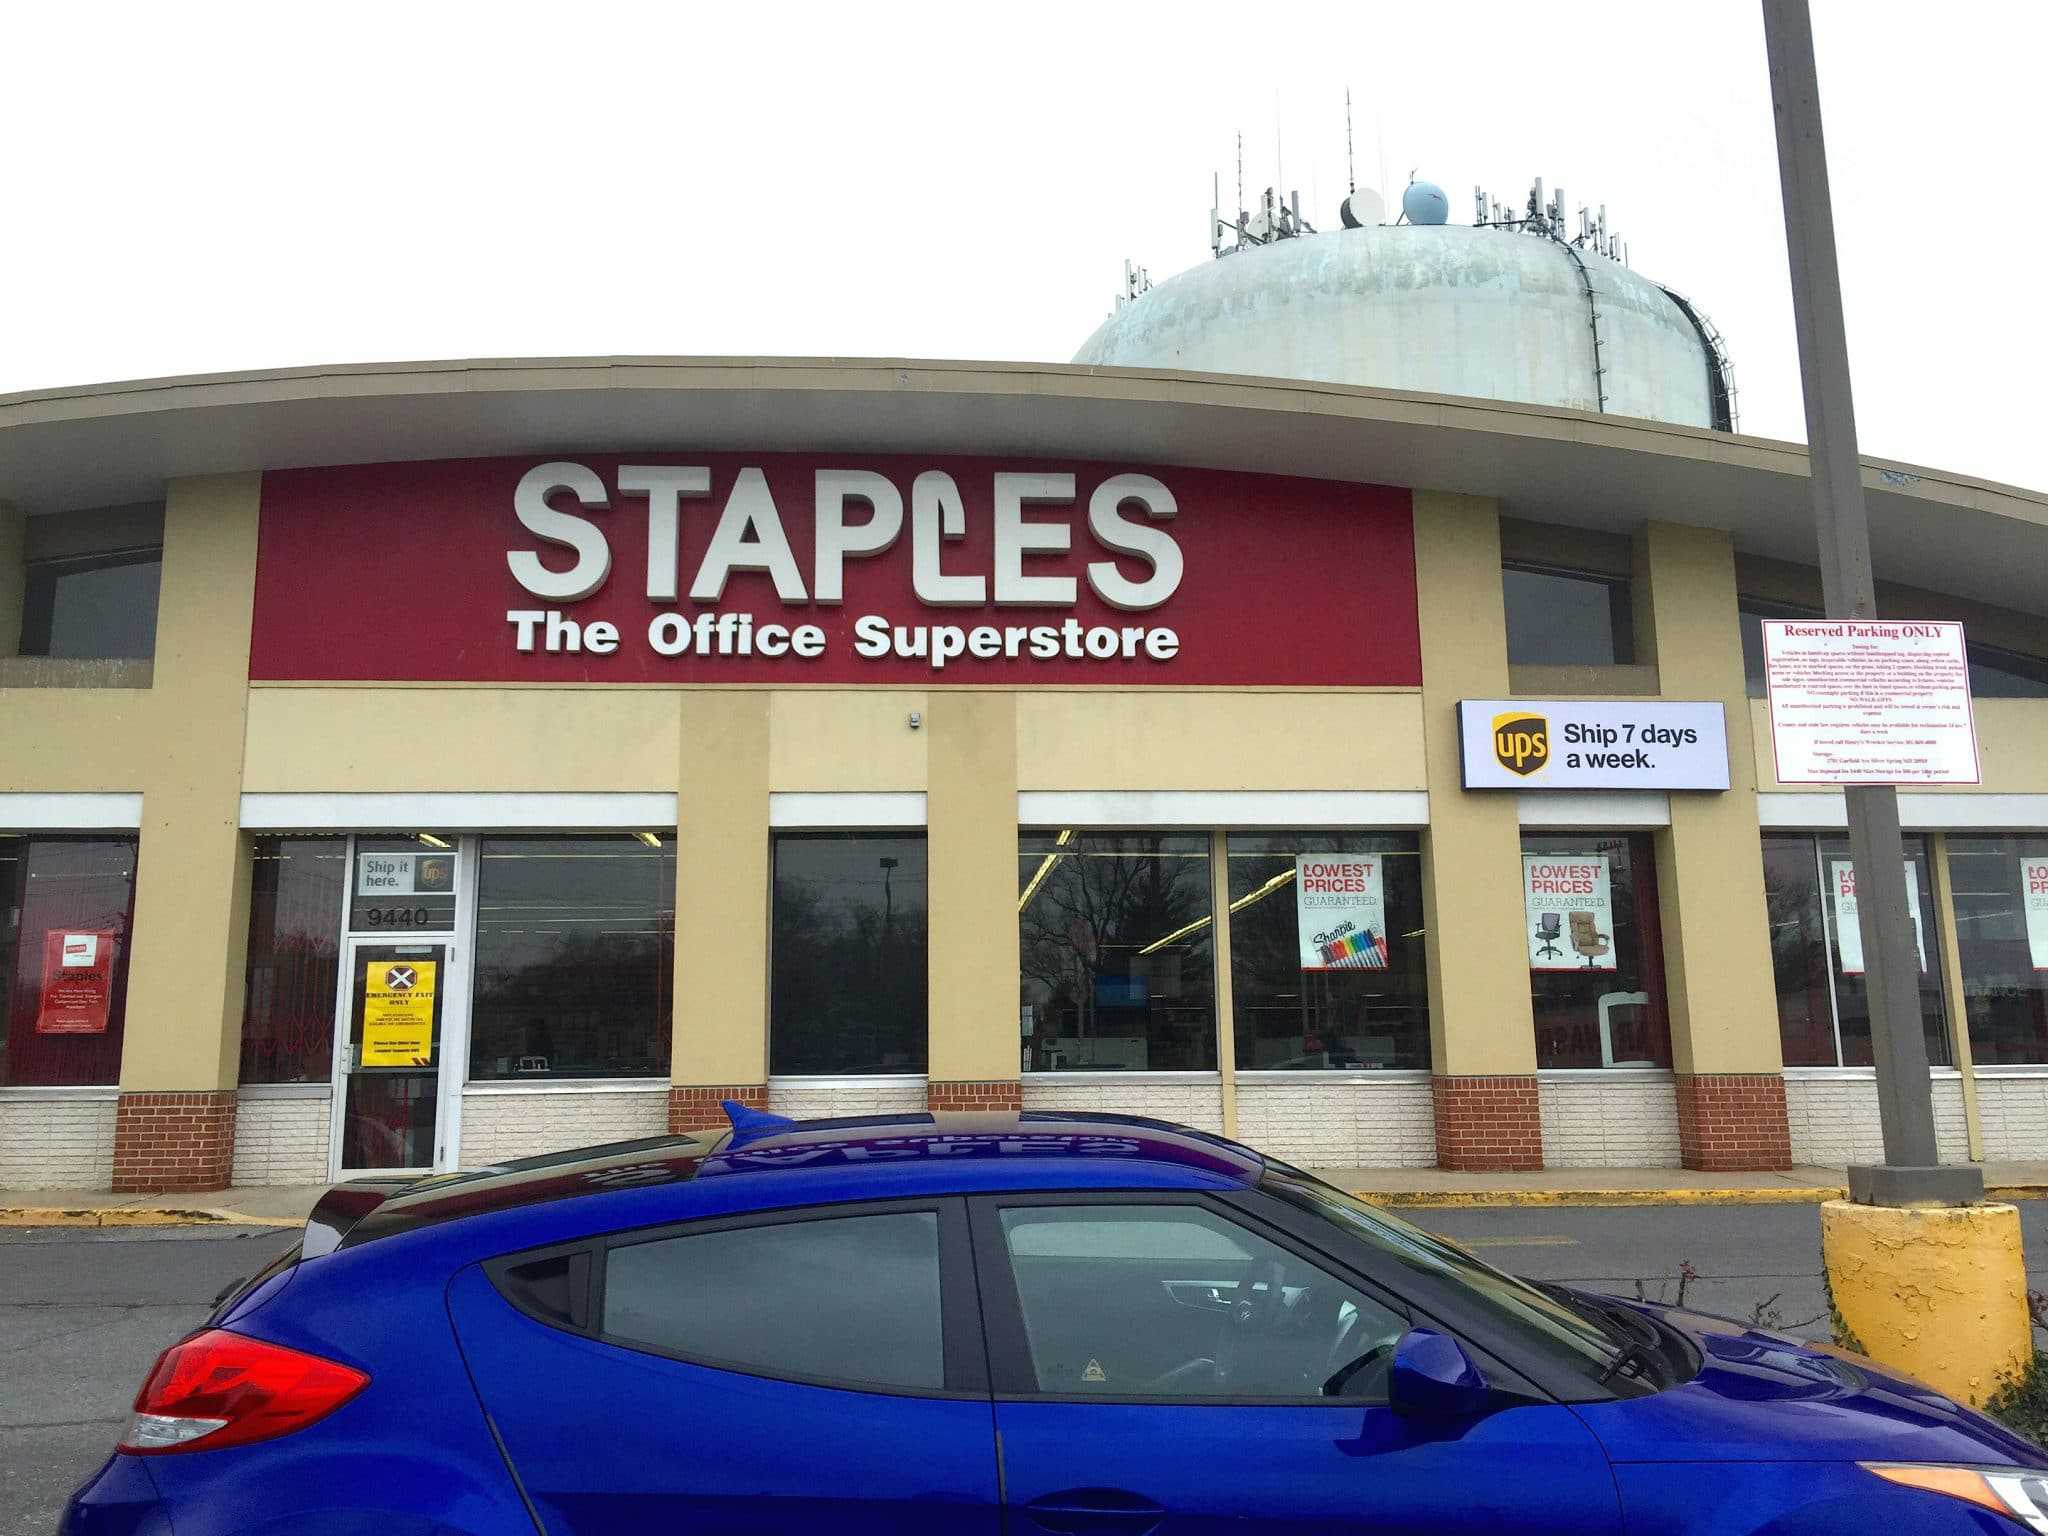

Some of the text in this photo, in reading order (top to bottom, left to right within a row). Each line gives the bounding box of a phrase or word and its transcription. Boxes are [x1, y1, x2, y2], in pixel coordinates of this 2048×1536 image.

[507, 462, 1184, 611] STAPLES
[507, 610, 1180, 670] The Office Superstore
[1784, 625, 1942, 640] Reserved Parking ONLY
[1564, 723, 1698, 748] Ship 7 days
[1498, 732, 1546, 768] ups
[1566, 749, 1656, 769] a week.
[367, 860, 409, 875] Ship it
[1303, 864, 1374, 878] LOWEST
[1530, 865, 1602, 879] LOWEST
[366, 875, 400, 887] here.
[1303, 879, 1366, 893] PRICES
[1531, 880, 1594, 893] PRICES
[367, 908, 429, 927] 9440
[1313, 920, 1357, 945] Sharpie
